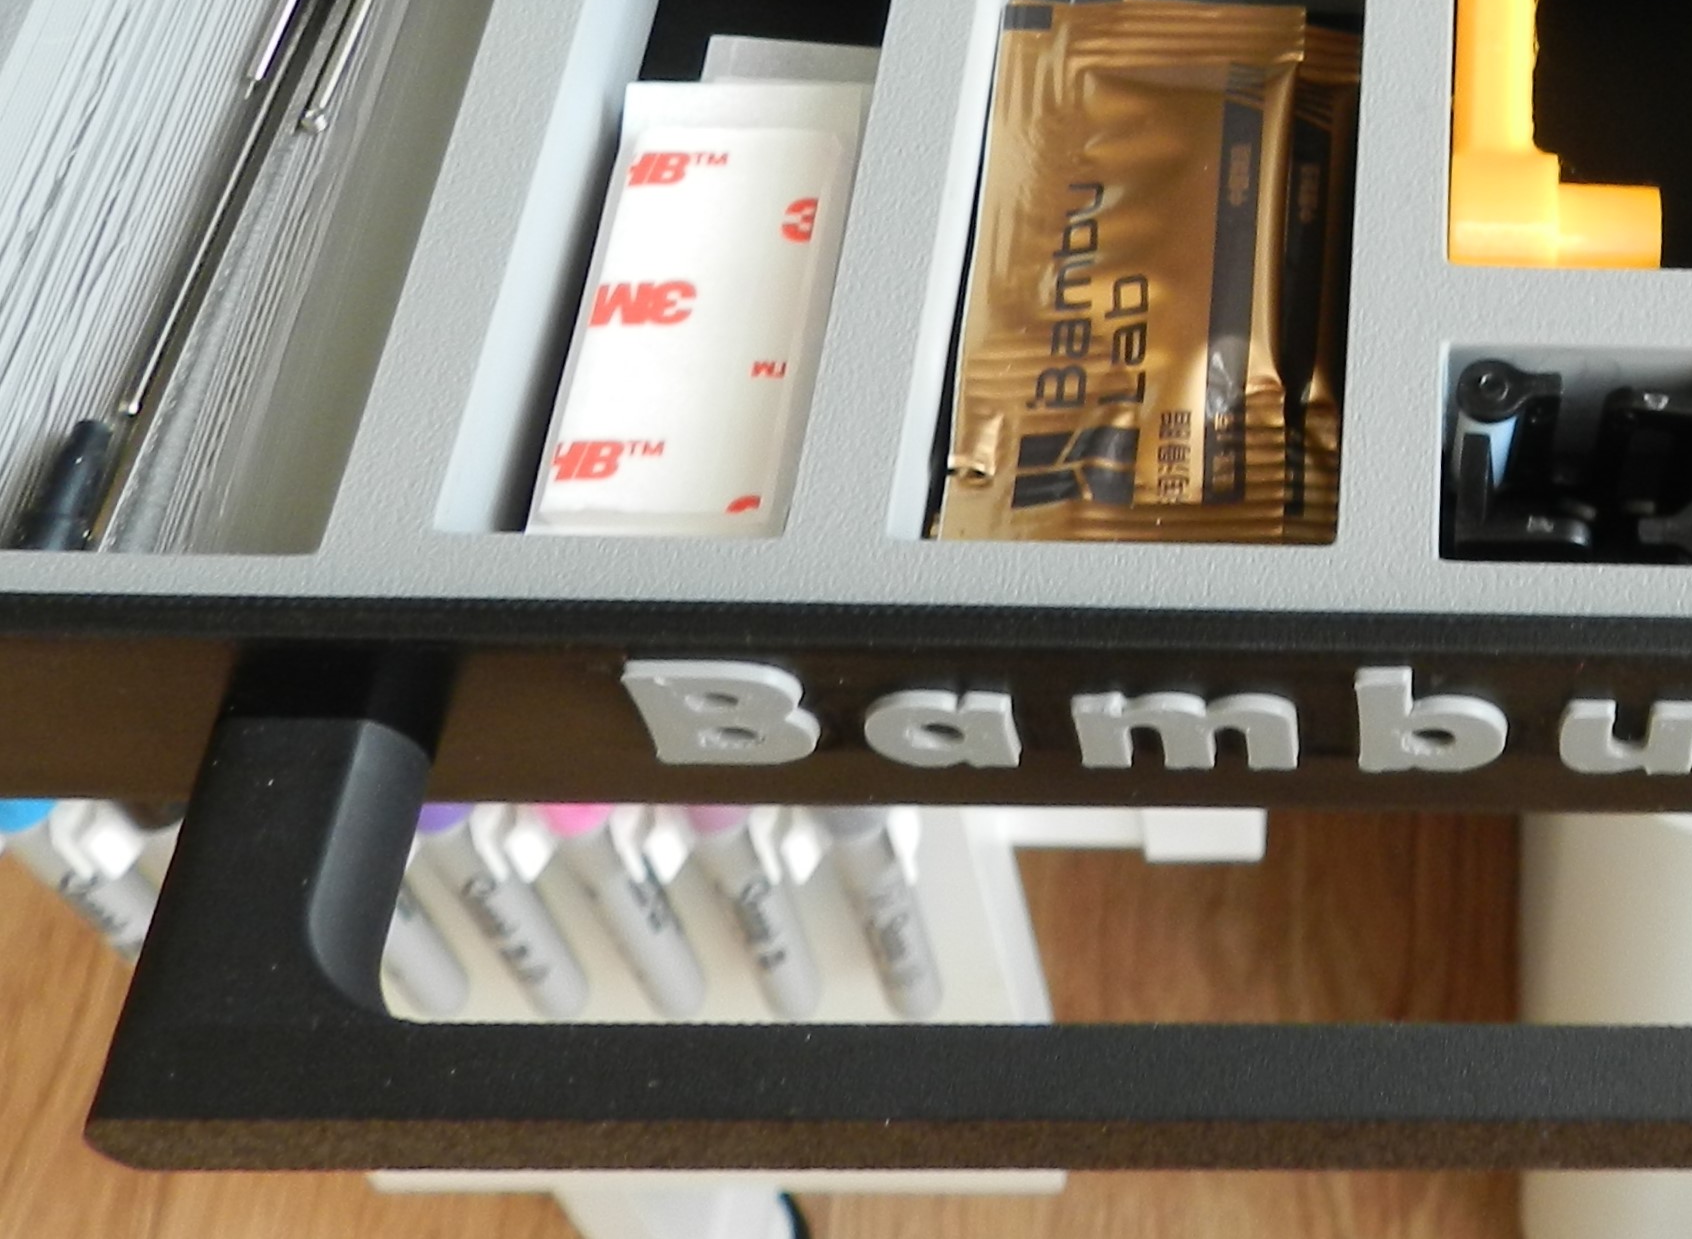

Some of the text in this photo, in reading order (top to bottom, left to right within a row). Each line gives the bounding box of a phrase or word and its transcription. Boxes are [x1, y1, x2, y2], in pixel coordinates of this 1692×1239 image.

[588, 280, 697, 328] 3M
[1026, 181, 1104, 409] Bambu
[1098, 273, 1149, 403] Lab
